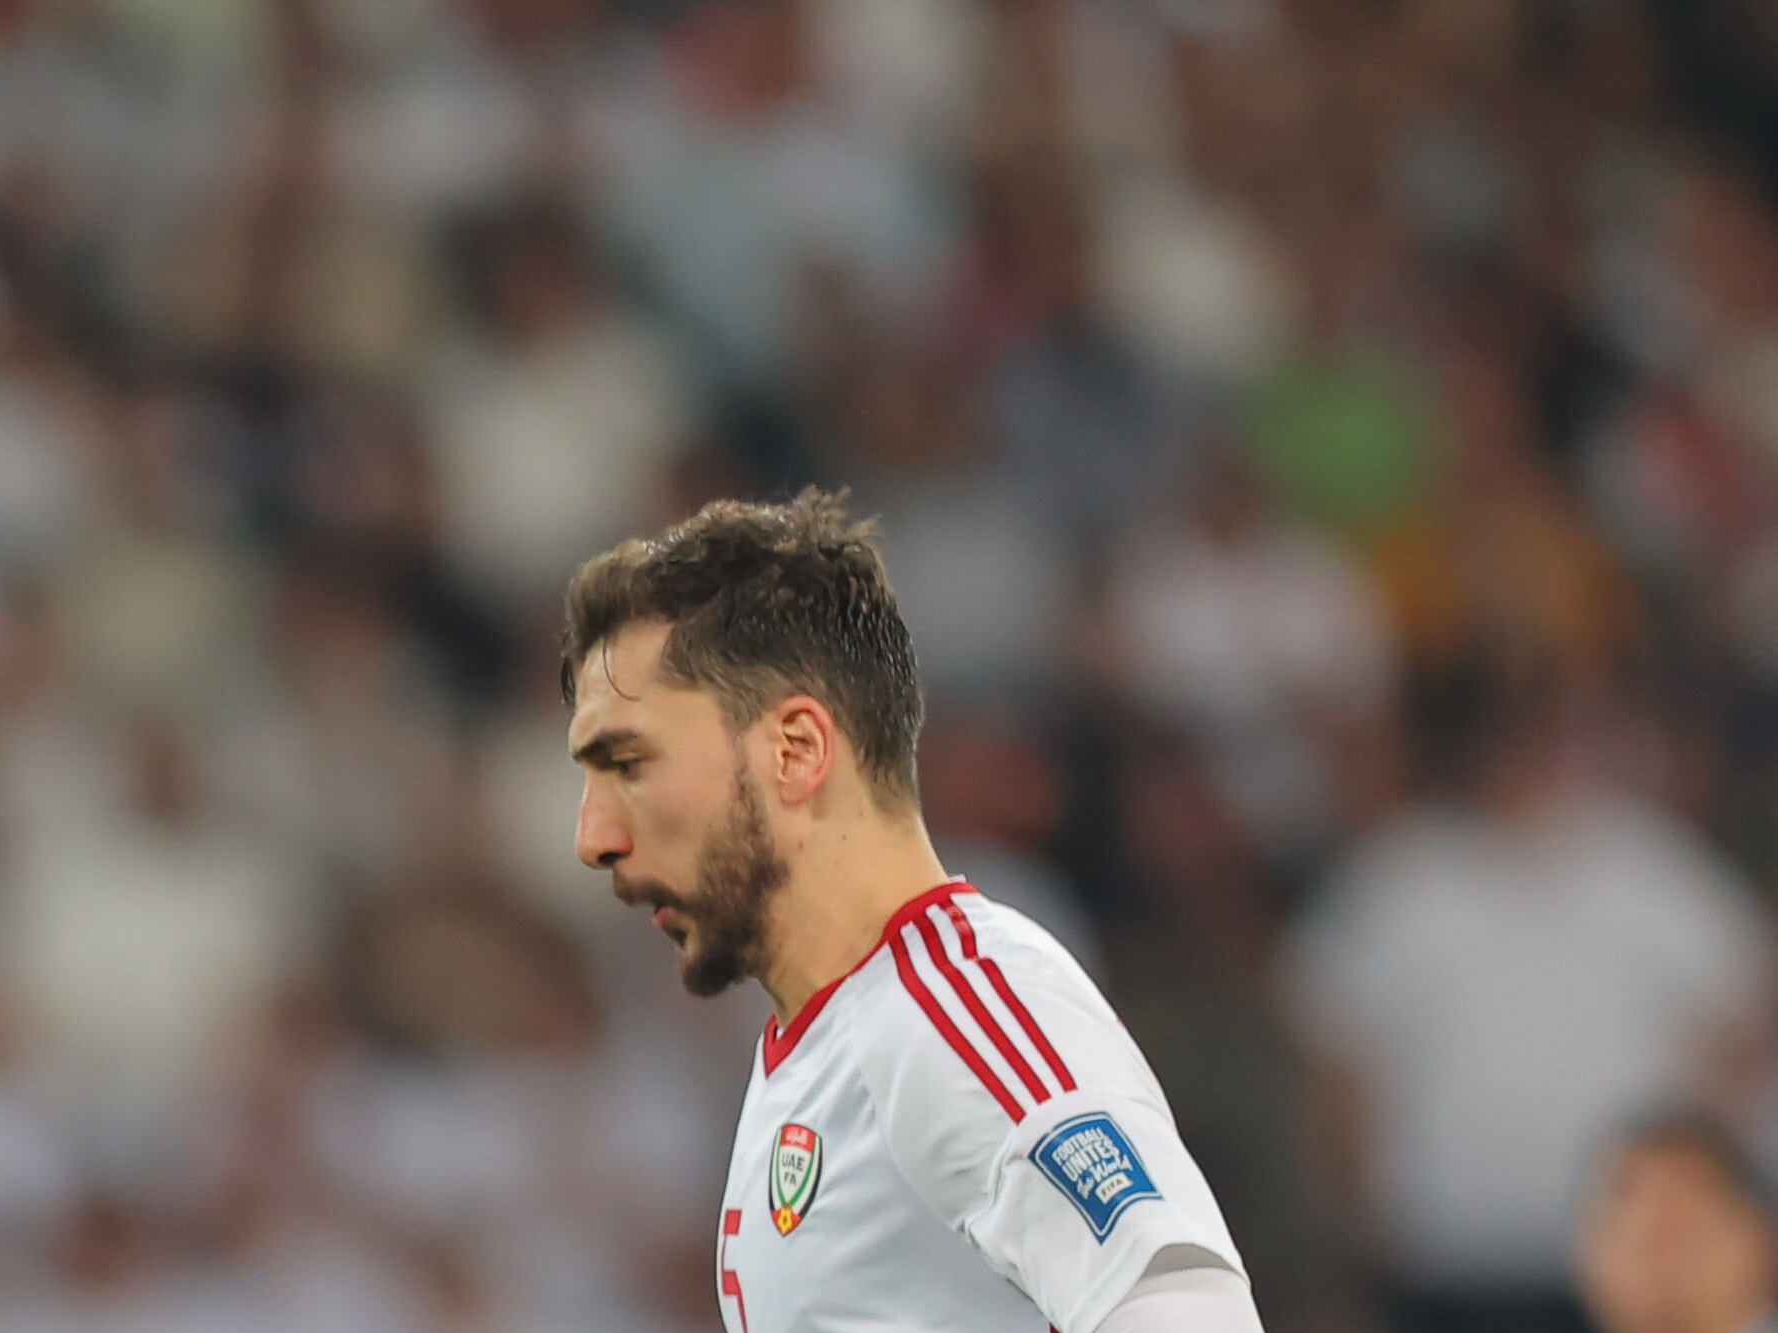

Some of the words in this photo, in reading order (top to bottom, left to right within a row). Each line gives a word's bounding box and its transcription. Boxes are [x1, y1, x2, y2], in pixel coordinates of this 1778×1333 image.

[781, 1152, 805, 1173] UAE
[1061, 1137, 1115, 1183] UNITES
[783, 1170, 798, 1187] FA
[1100, 1178, 1124, 1198] FIFA
